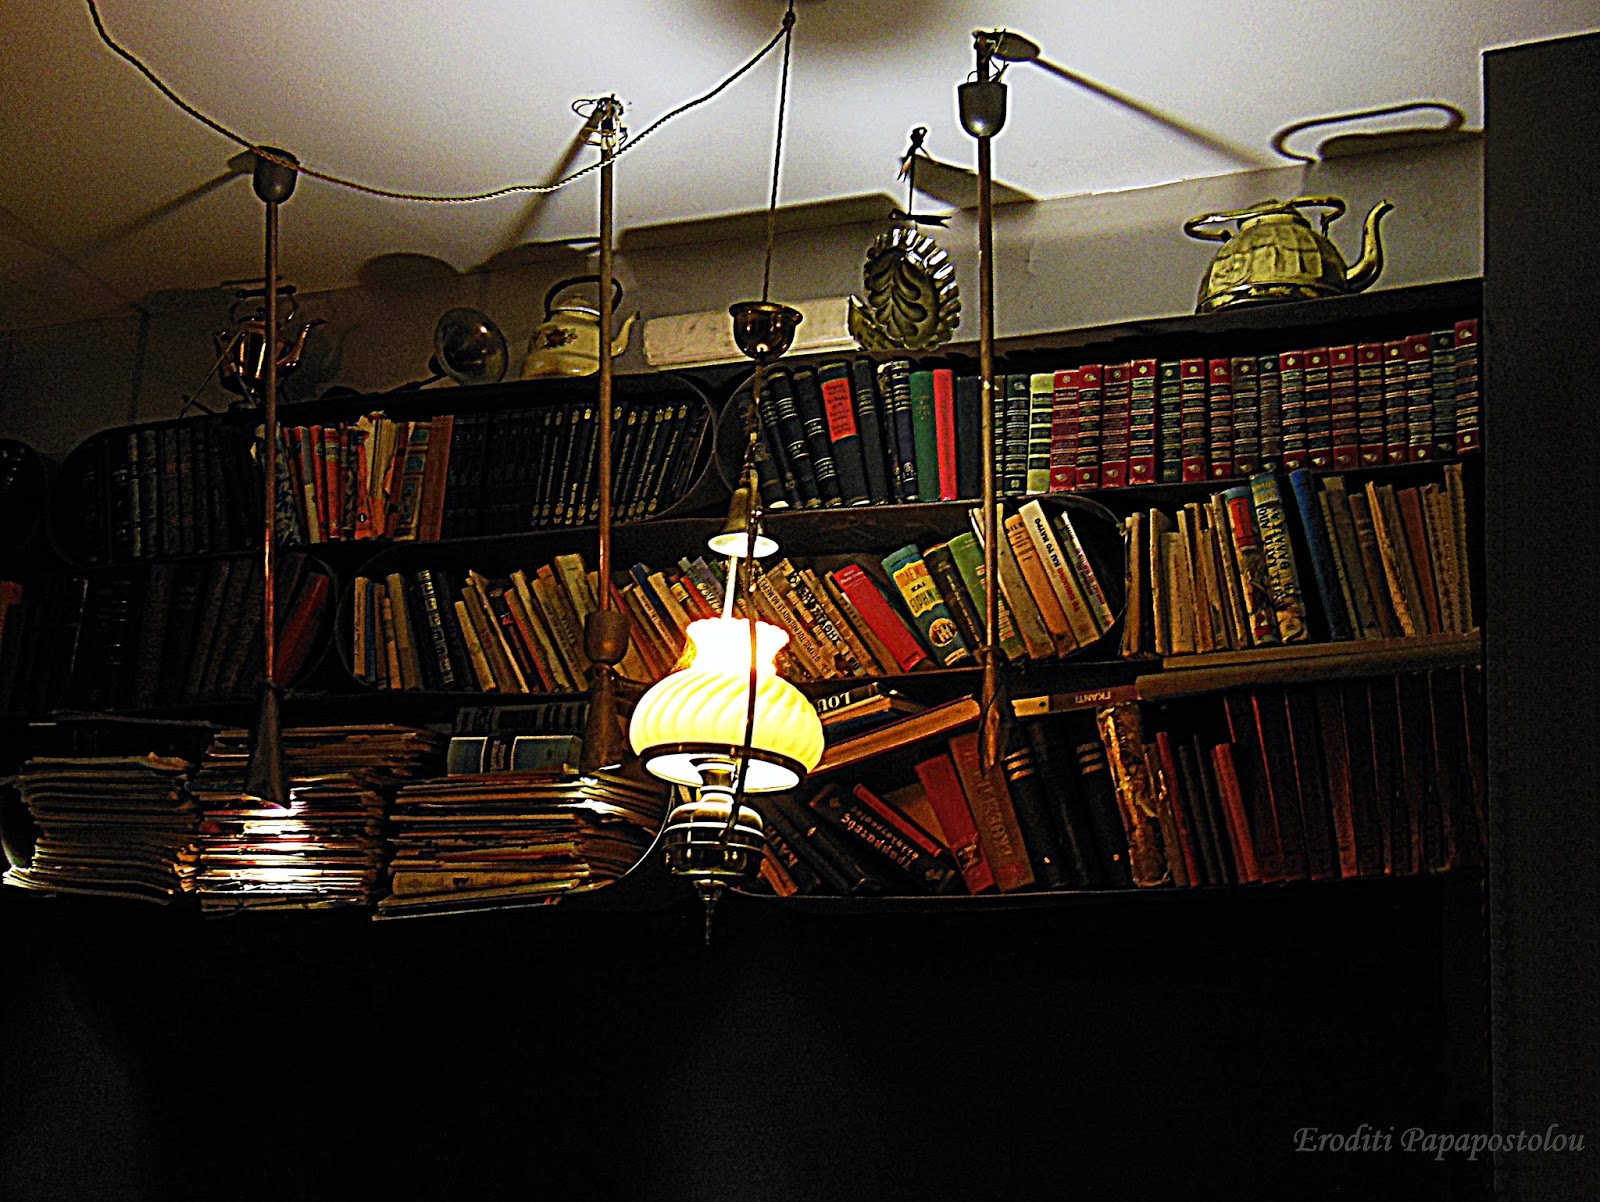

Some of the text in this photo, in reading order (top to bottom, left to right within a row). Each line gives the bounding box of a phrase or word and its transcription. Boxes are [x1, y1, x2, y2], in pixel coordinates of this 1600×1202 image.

[1033, 517, 1050, 543] ΜΑΥΡΟ
[1045, 542, 1054, 554] ΤΟ
[910, 580, 926, 592] ΚΑΙ
